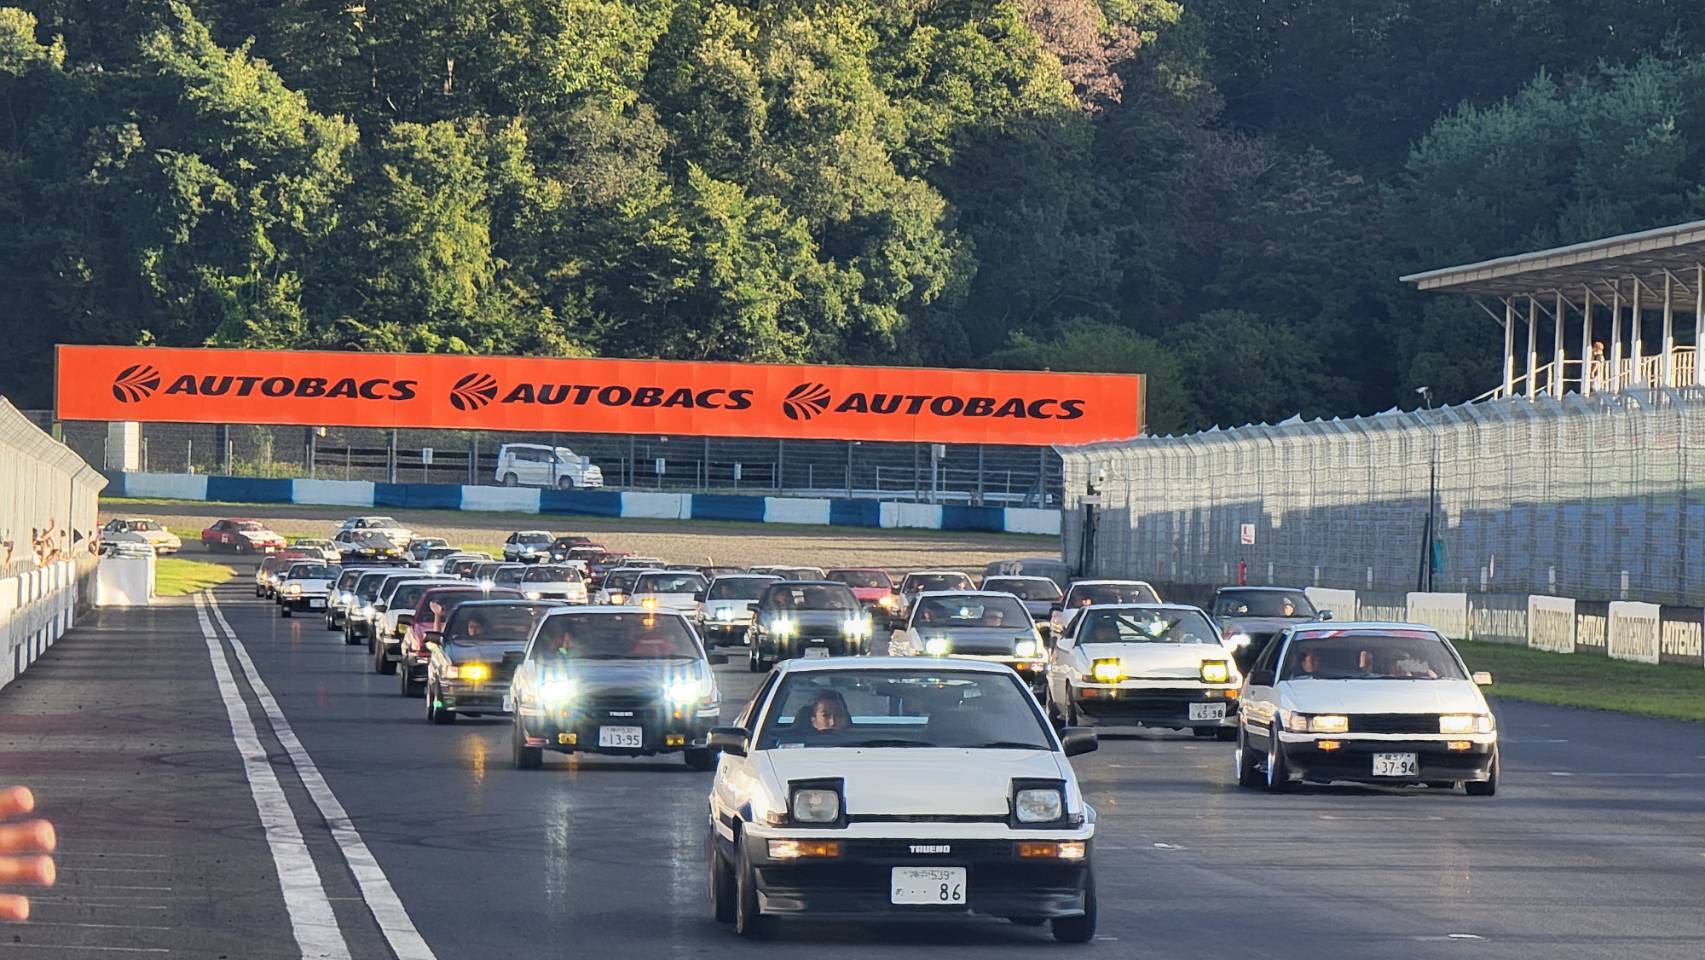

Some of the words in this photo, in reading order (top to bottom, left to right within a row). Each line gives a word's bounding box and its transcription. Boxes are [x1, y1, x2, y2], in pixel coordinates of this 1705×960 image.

[164, 375, 417, 400] AUTOBACS
[501, 383, 753, 410] AUTOBACS
[834, 393, 1085, 419] AUTOBACS
[1662, 620, 1702, 656] POTENZA
[610, 734, 639, 745] 13-95
[1382, 761, 1415, 773] 37-94
[909, 845, 951, 854] TRUENO
[940, 883, 961, 901] 86
